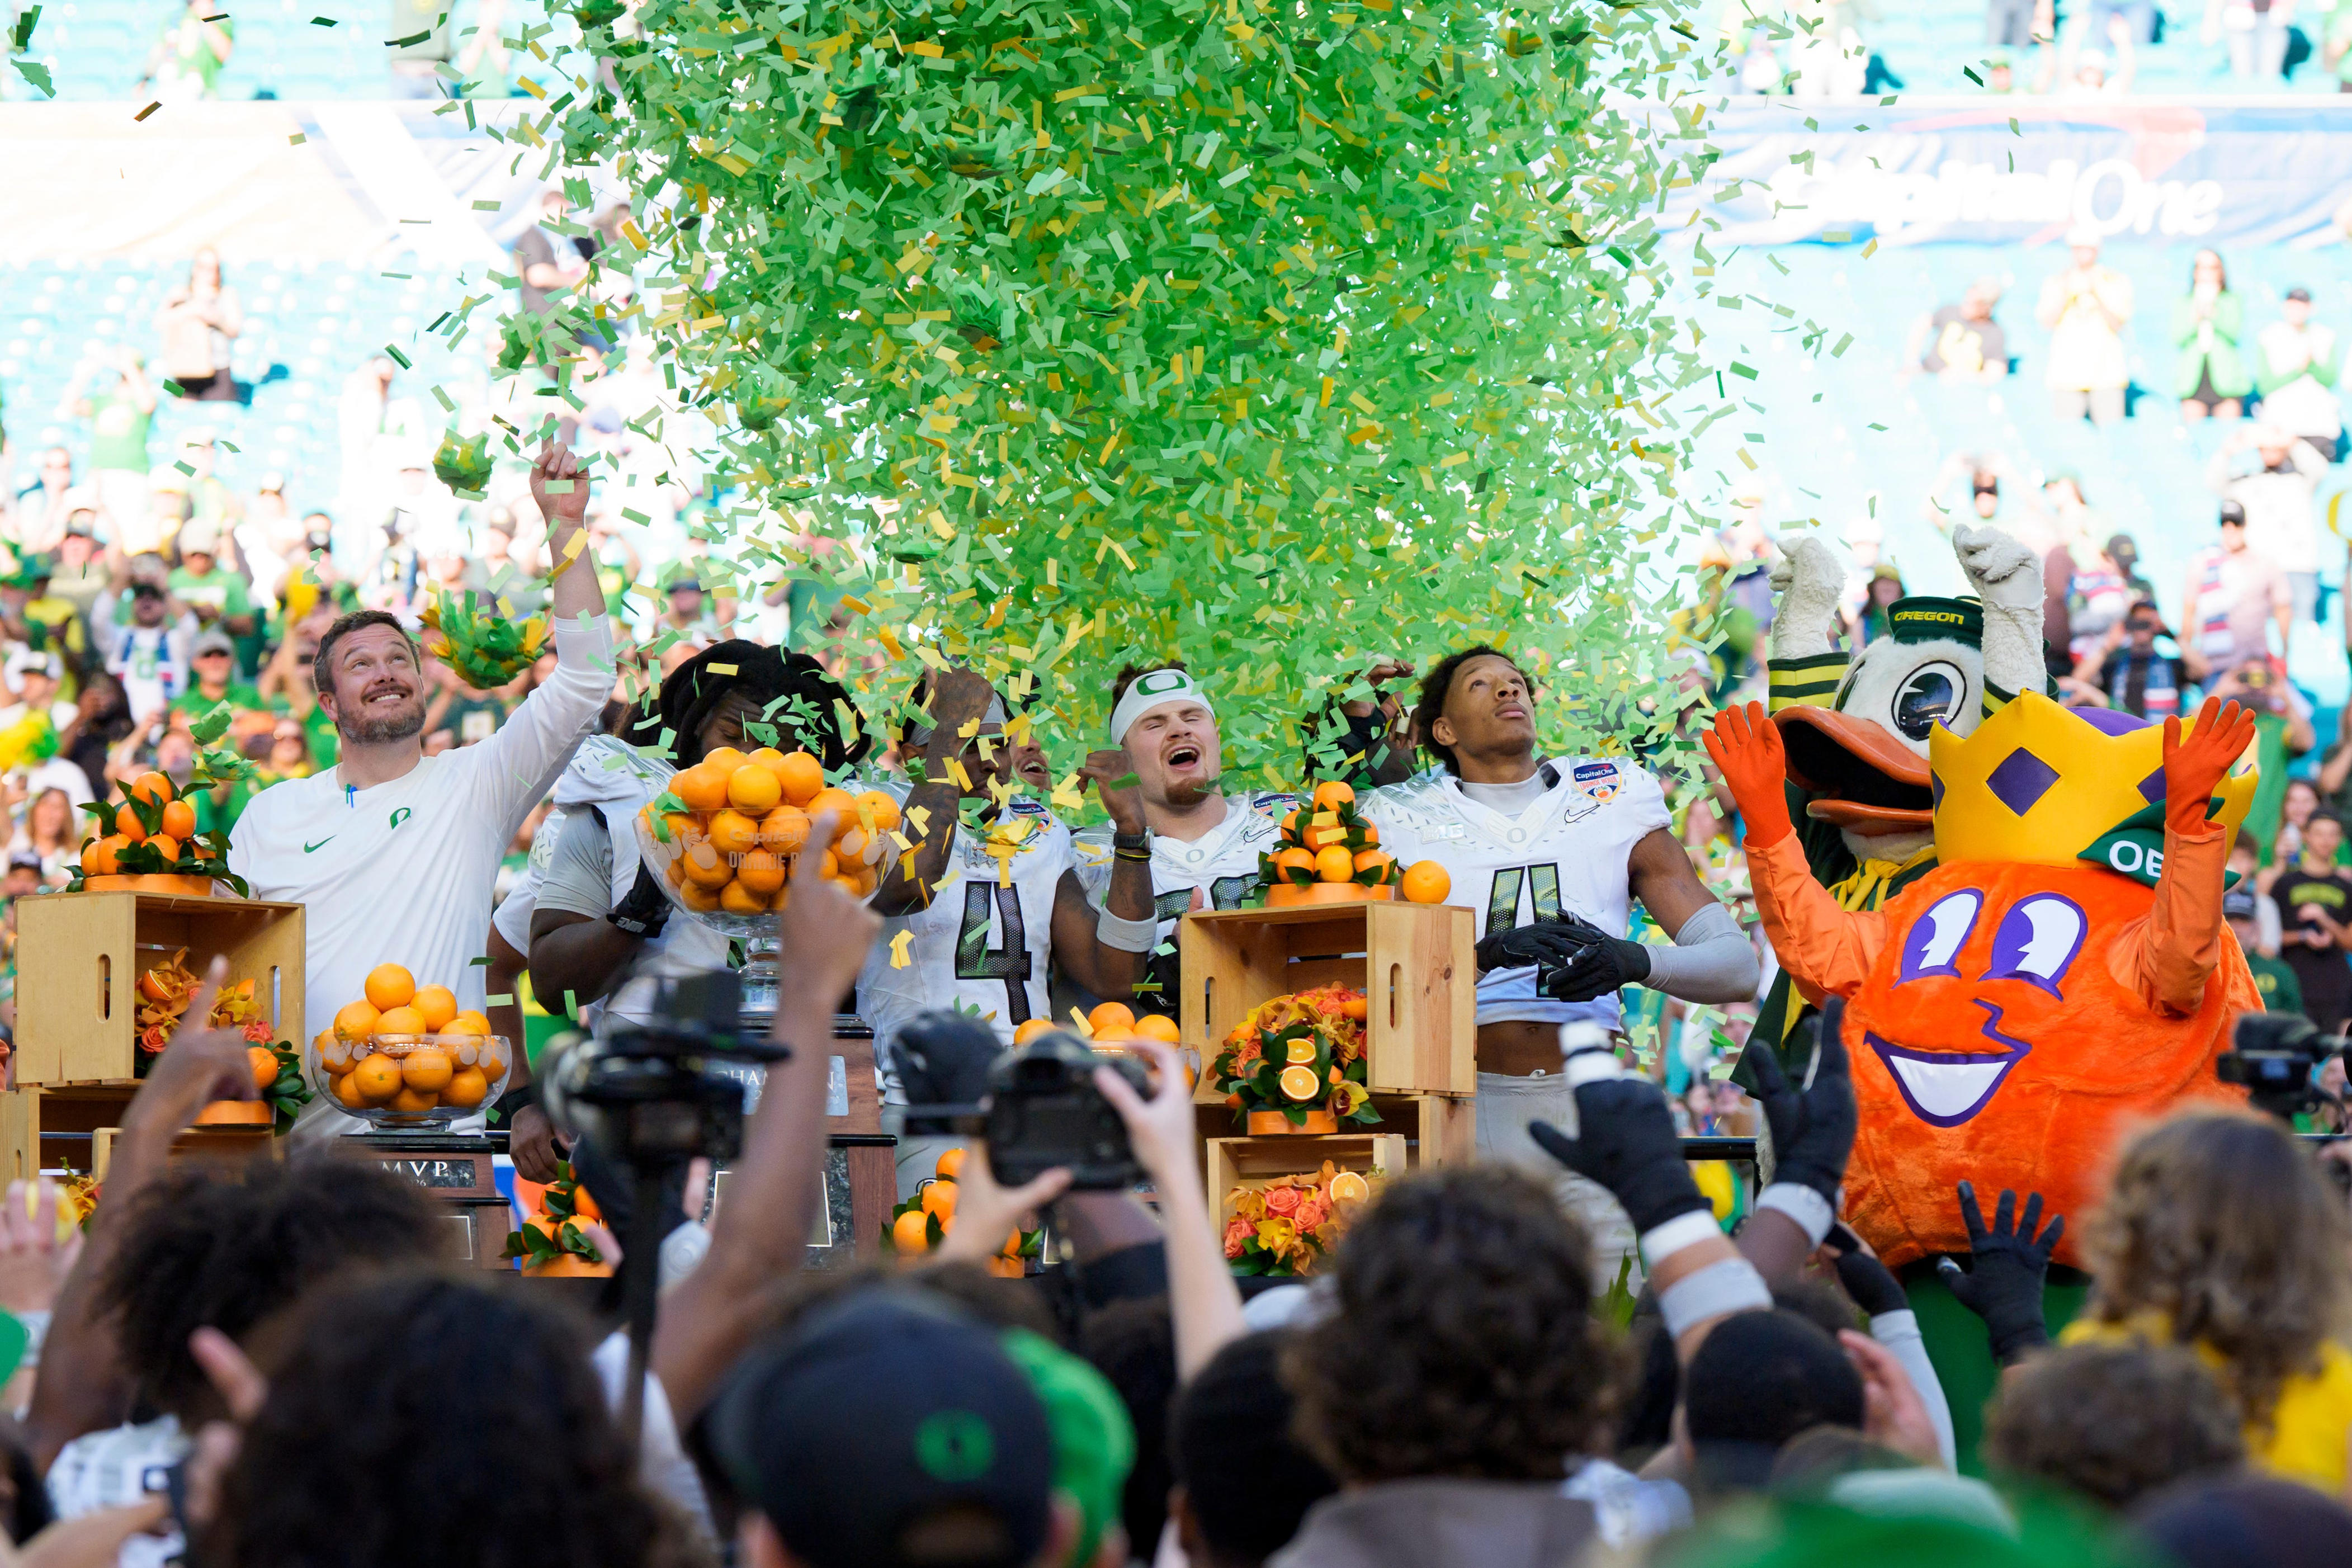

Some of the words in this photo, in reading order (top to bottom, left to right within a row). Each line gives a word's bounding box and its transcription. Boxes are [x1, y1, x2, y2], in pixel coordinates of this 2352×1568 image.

[1894, 611, 1964, 625] OREGON
[729, 851, 786, 870] ORANGE
[955, 881, 1032, 1026] 4
[382, 1161, 448, 1177] MVP
